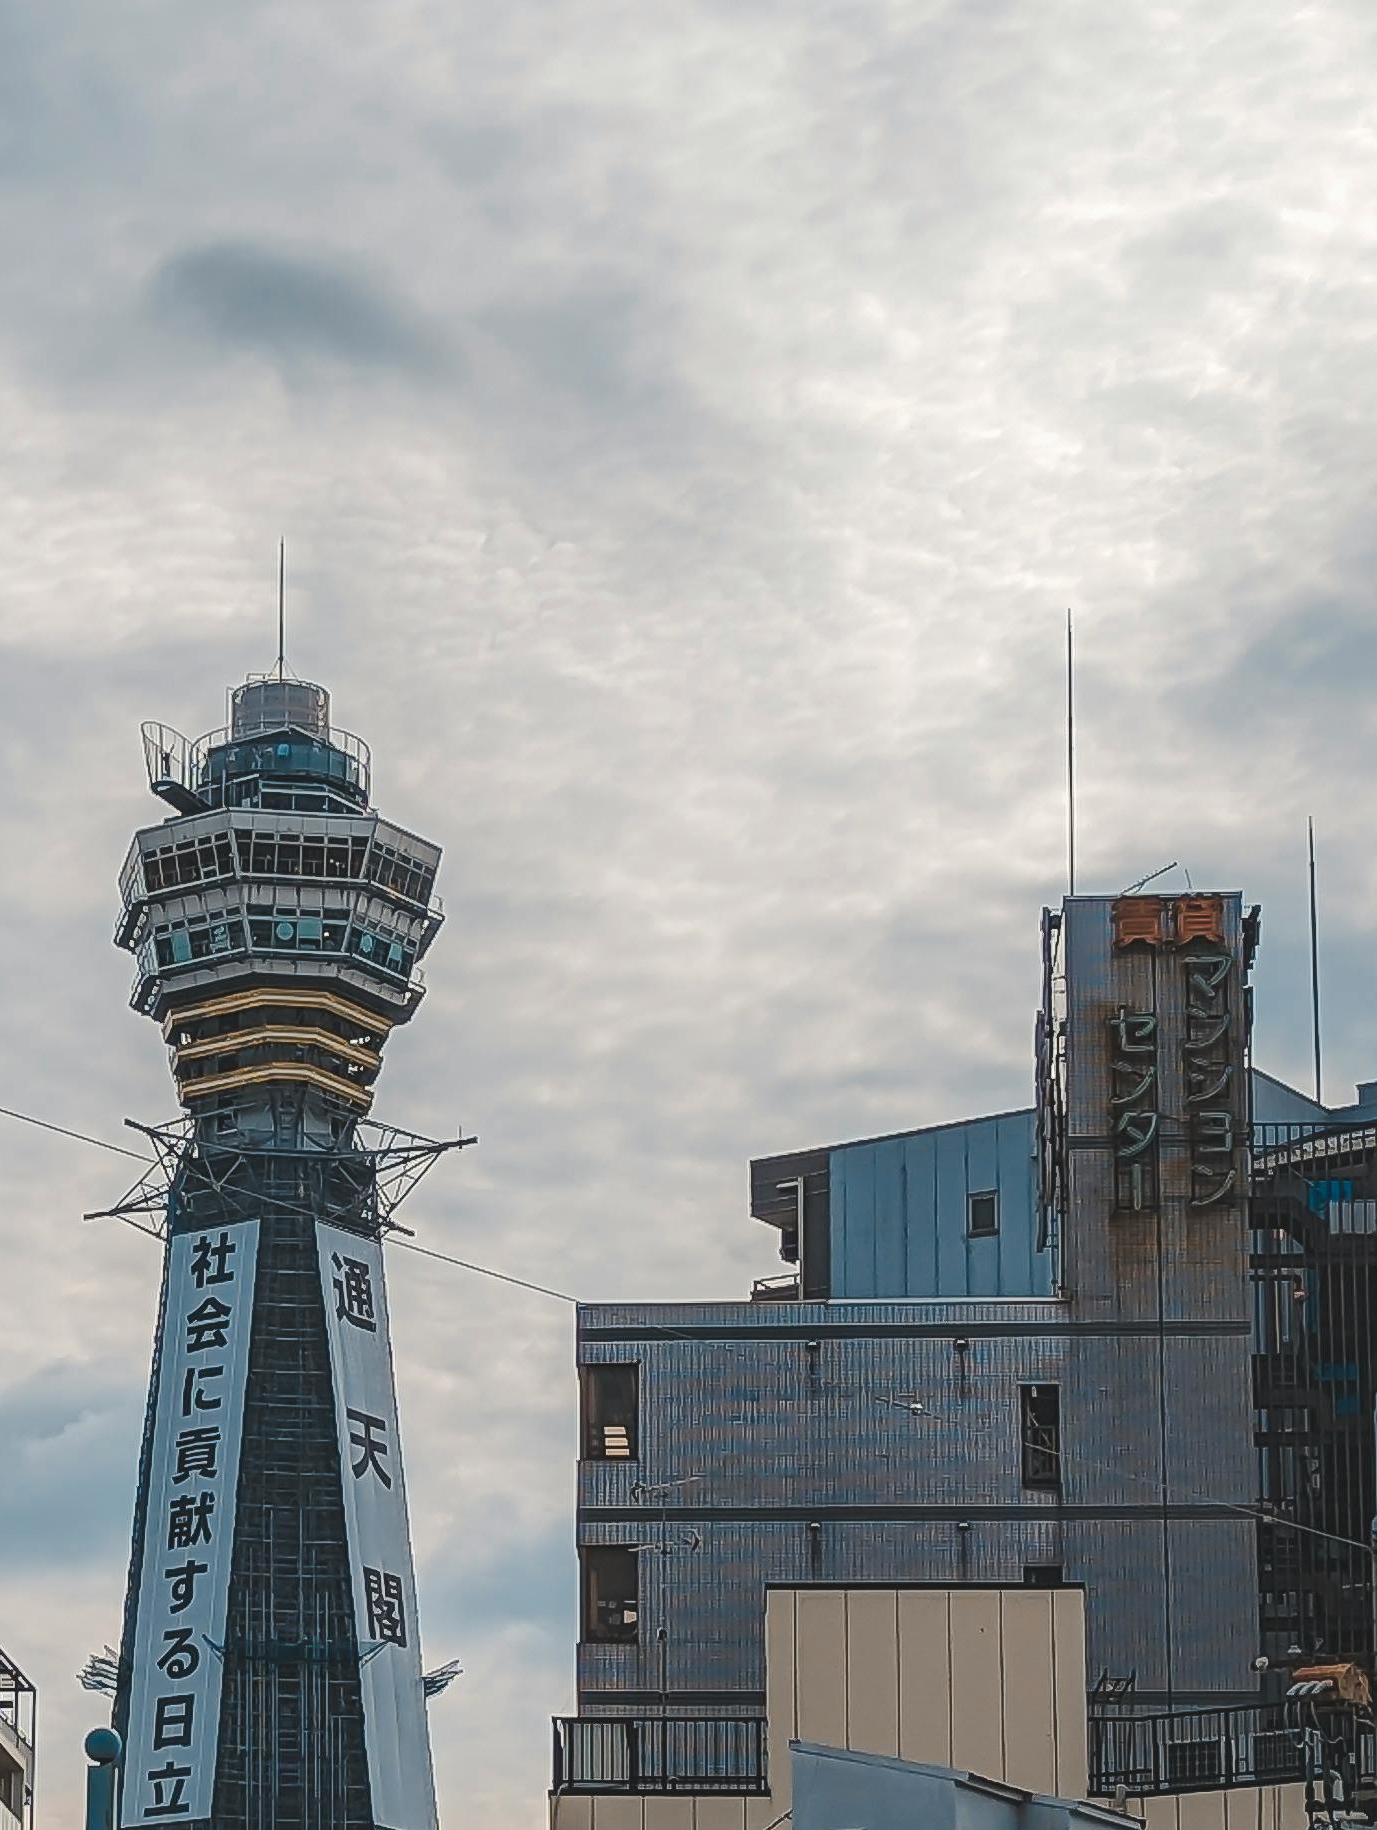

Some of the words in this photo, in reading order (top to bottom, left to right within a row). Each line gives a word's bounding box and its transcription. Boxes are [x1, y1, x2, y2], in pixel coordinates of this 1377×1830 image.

[1110, 1003, 1159, 1212] センター
[142, 1231, 237, 1818] 社会に貢献する日立
[331, 1250, 407, 1649] 通天閣
